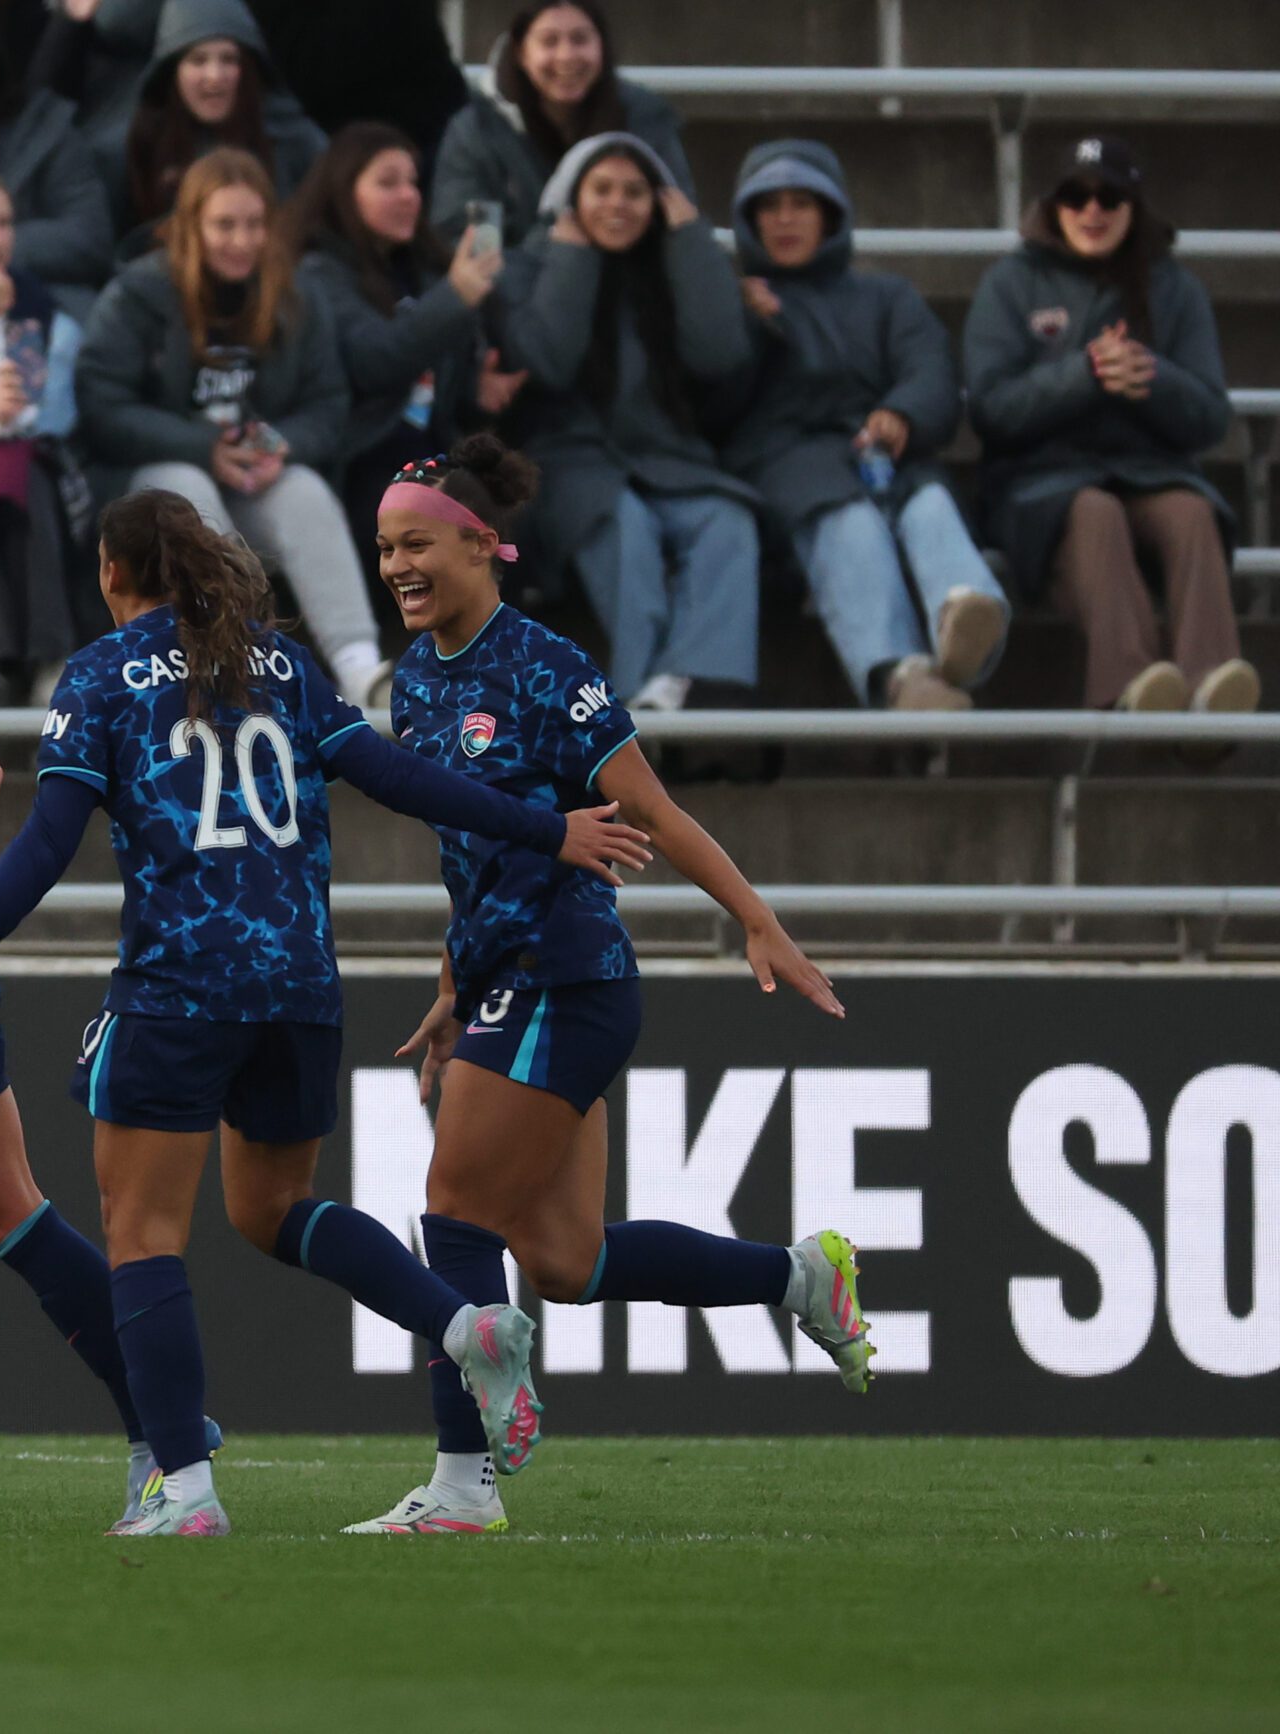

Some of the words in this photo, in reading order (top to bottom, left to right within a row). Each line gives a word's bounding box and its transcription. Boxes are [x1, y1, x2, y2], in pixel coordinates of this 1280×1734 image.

[570, 681, 611, 722] ally
[41, 708, 72, 740] lly
[169, 713, 299, 850] 20
